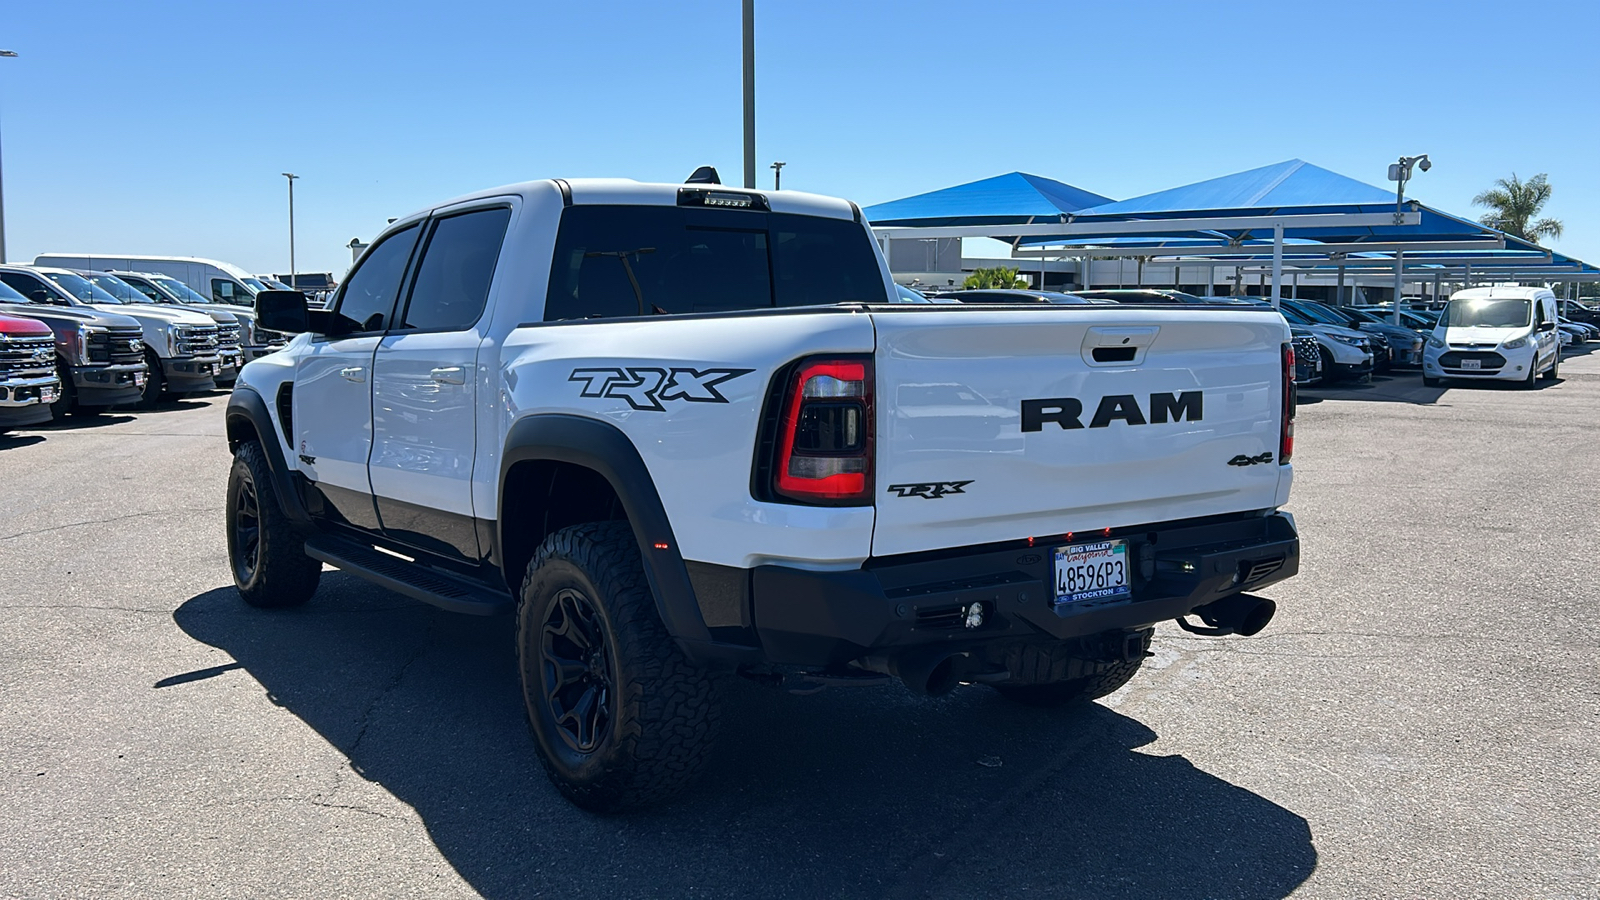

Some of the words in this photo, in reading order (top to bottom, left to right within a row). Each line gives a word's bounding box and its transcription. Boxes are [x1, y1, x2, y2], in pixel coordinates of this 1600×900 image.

[568, 367, 757, 412] TRX
[1020, 391, 1203, 433] RAM
[1227, 451, 1274, 467] 4x4
[887, 480, 976, 500] TRX
[1070, 546, 1084, 554] BIG
[1085, 543, 1110, 552] VALLEY
[1058, 560, 1124, 594] 48596P3
[1072, 588, 1114, 601] STOCKTON
